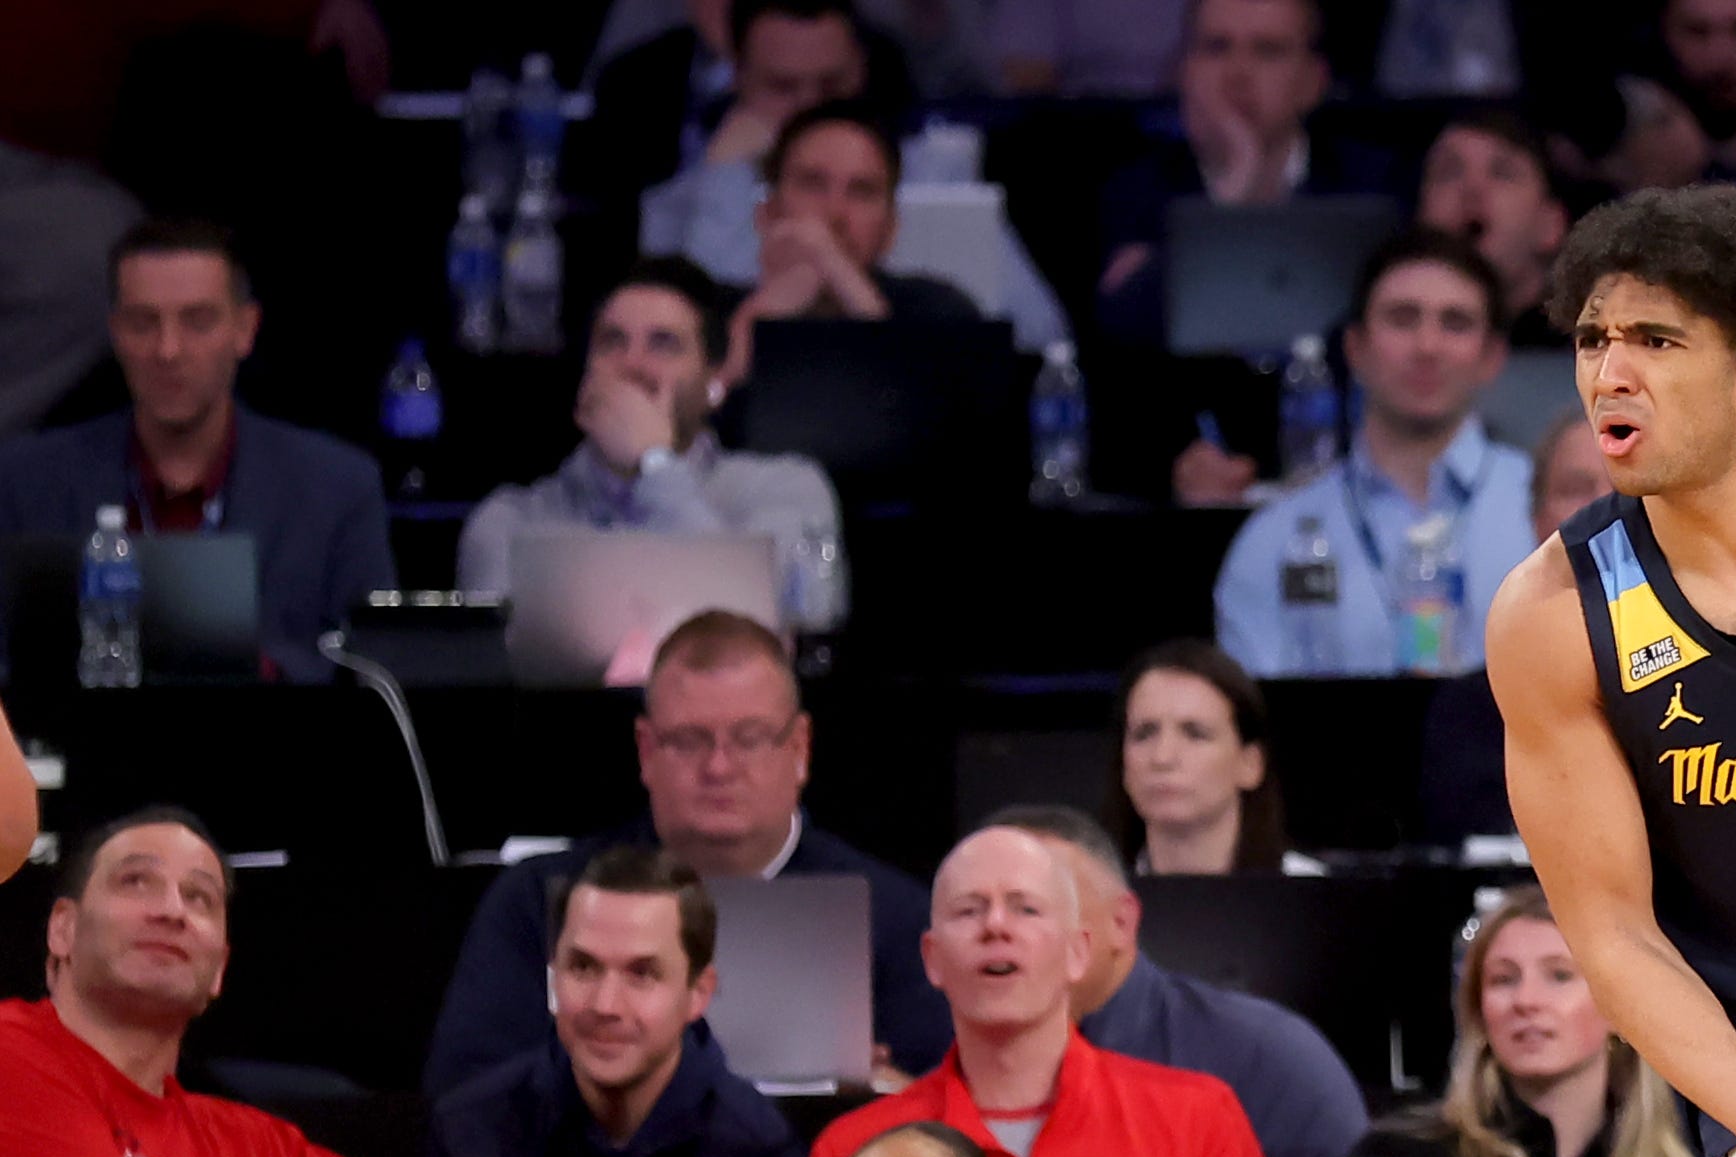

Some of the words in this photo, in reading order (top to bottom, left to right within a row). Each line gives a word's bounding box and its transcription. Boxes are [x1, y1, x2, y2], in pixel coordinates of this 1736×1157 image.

[1630, 648, 1649, 667] BE
[1648, 637, 1674, 658] THE
[1631, 648, 1681, 680] CHANGE
